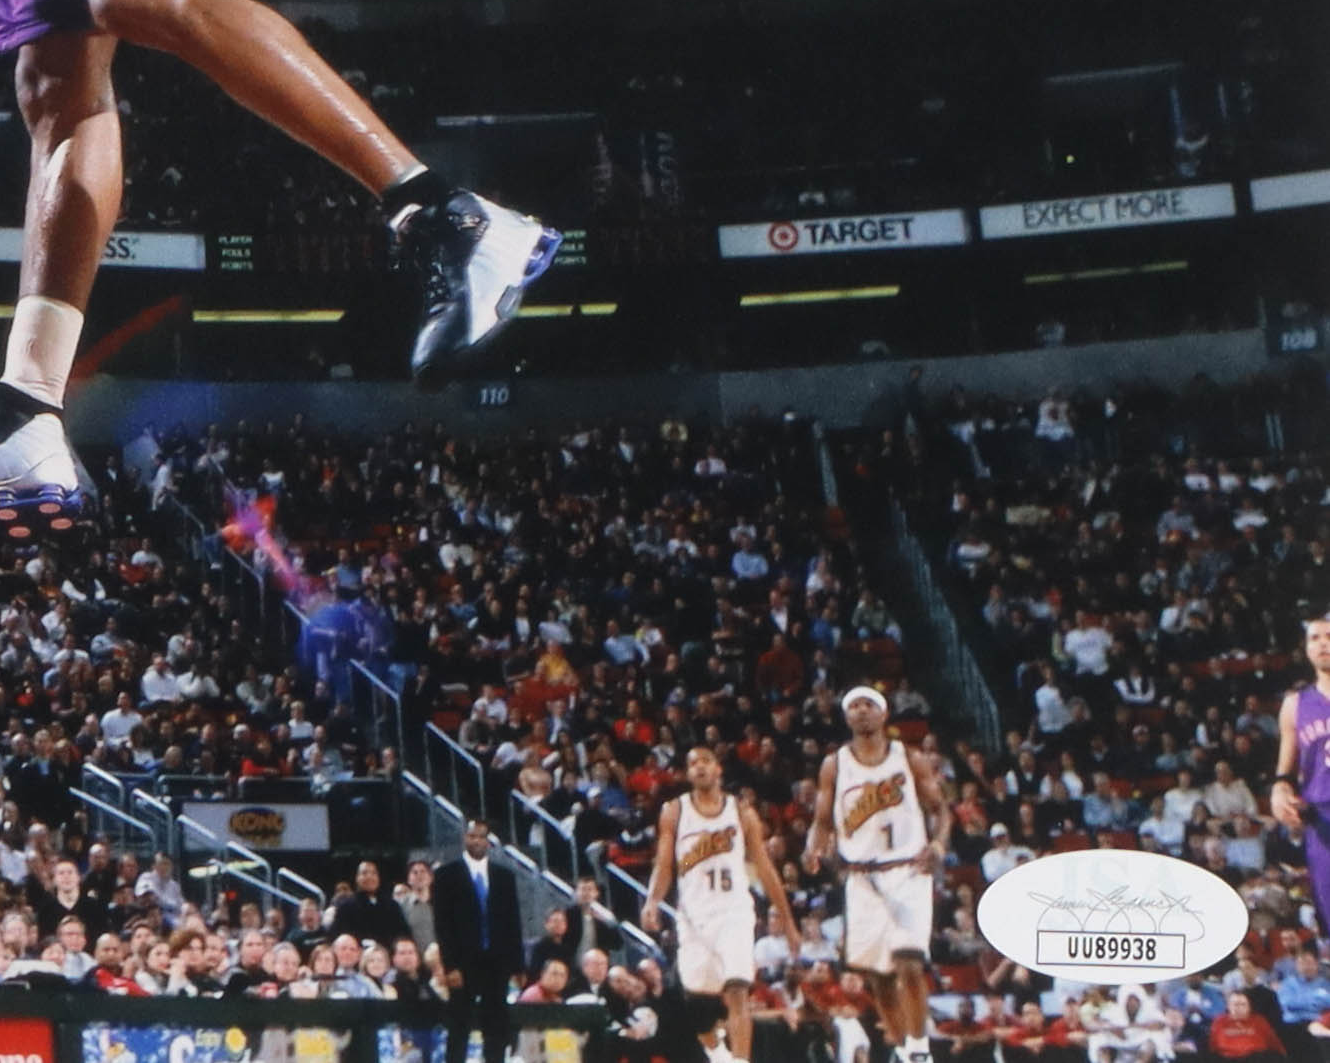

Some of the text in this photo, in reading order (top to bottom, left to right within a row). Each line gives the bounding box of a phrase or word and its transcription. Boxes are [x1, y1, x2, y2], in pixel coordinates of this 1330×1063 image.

[1022, 192, 1186, 229] EXPECT MORE
[804, 217, 914, 245] TARGET
[479, 389, 510, 405] 110
[1068, 936, 1157, 961] UU89938
